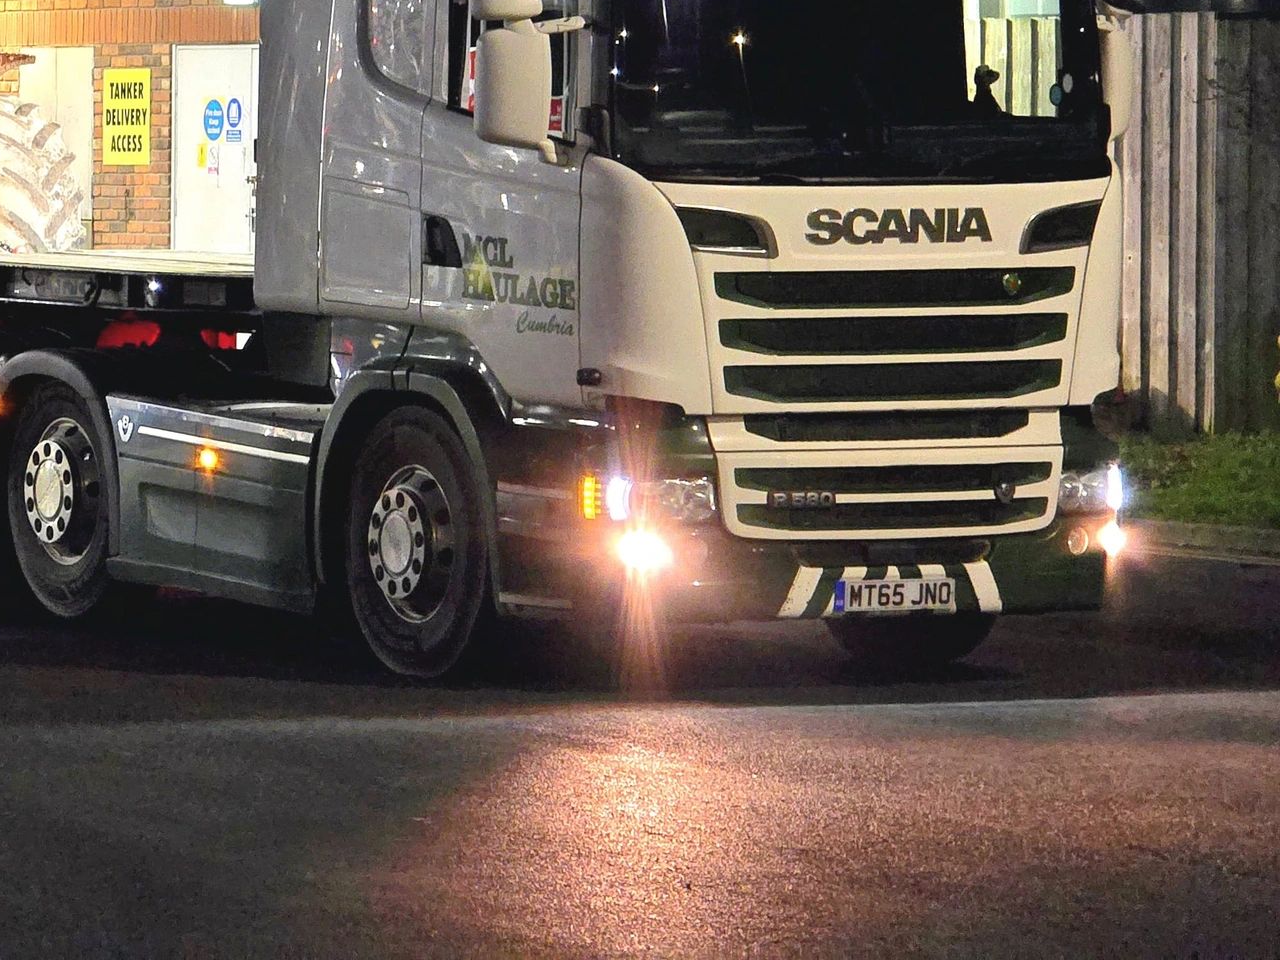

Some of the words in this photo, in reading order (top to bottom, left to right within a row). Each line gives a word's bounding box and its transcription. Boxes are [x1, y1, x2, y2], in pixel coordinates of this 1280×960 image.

[109, 82, 144, 99] TANKER
[105, 109, 148, 126] DELIVERY
[110, 134, 143, 152] ACCESS
[805, 207, 992, 244] SCANIA
[462, 233, 514, 268] MCL
[462, 269, 576, 310] HAULAGE
[516, 310, 575, 336] Cumbria
[848, 583, 905, 607] MT65
